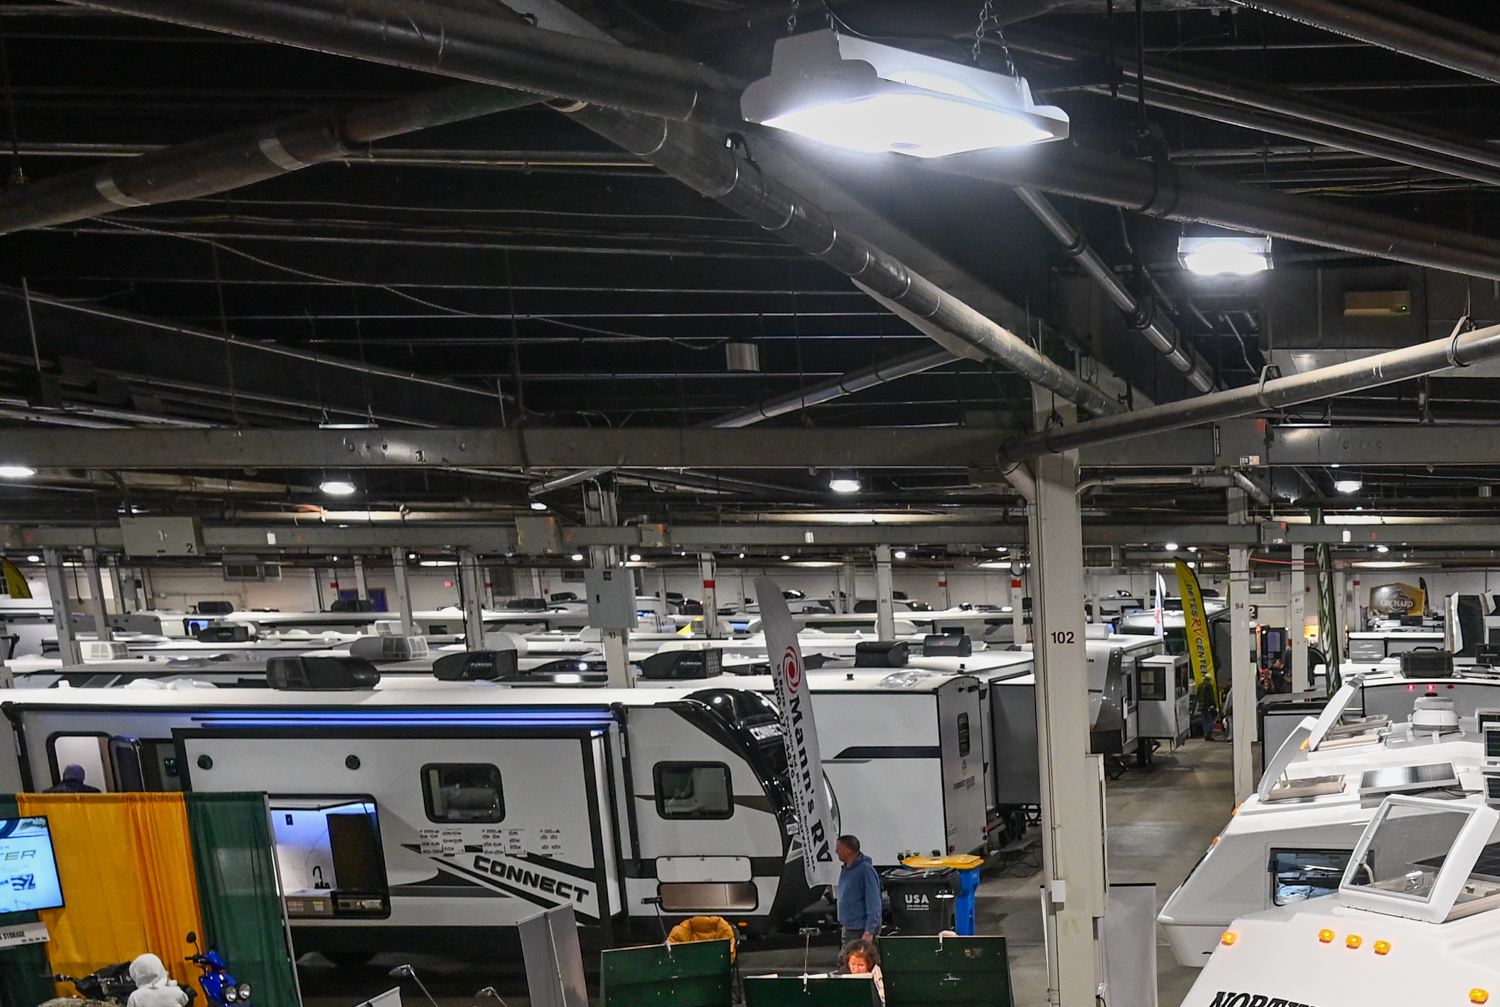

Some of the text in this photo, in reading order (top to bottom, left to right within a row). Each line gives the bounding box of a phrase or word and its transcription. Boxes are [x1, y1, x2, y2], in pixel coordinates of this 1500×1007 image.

[1235, 602, 1244, 610] 94
[1050, 631, 1075, 644] 102
[1191, 618, 1205, 638] RV
[749, 723, 783, 743] CONNEC
[789, 697, 833, 863] Mann's RV
[473, 855, 589, 903] CONNECT
[905, 894, 929, 904] USA
